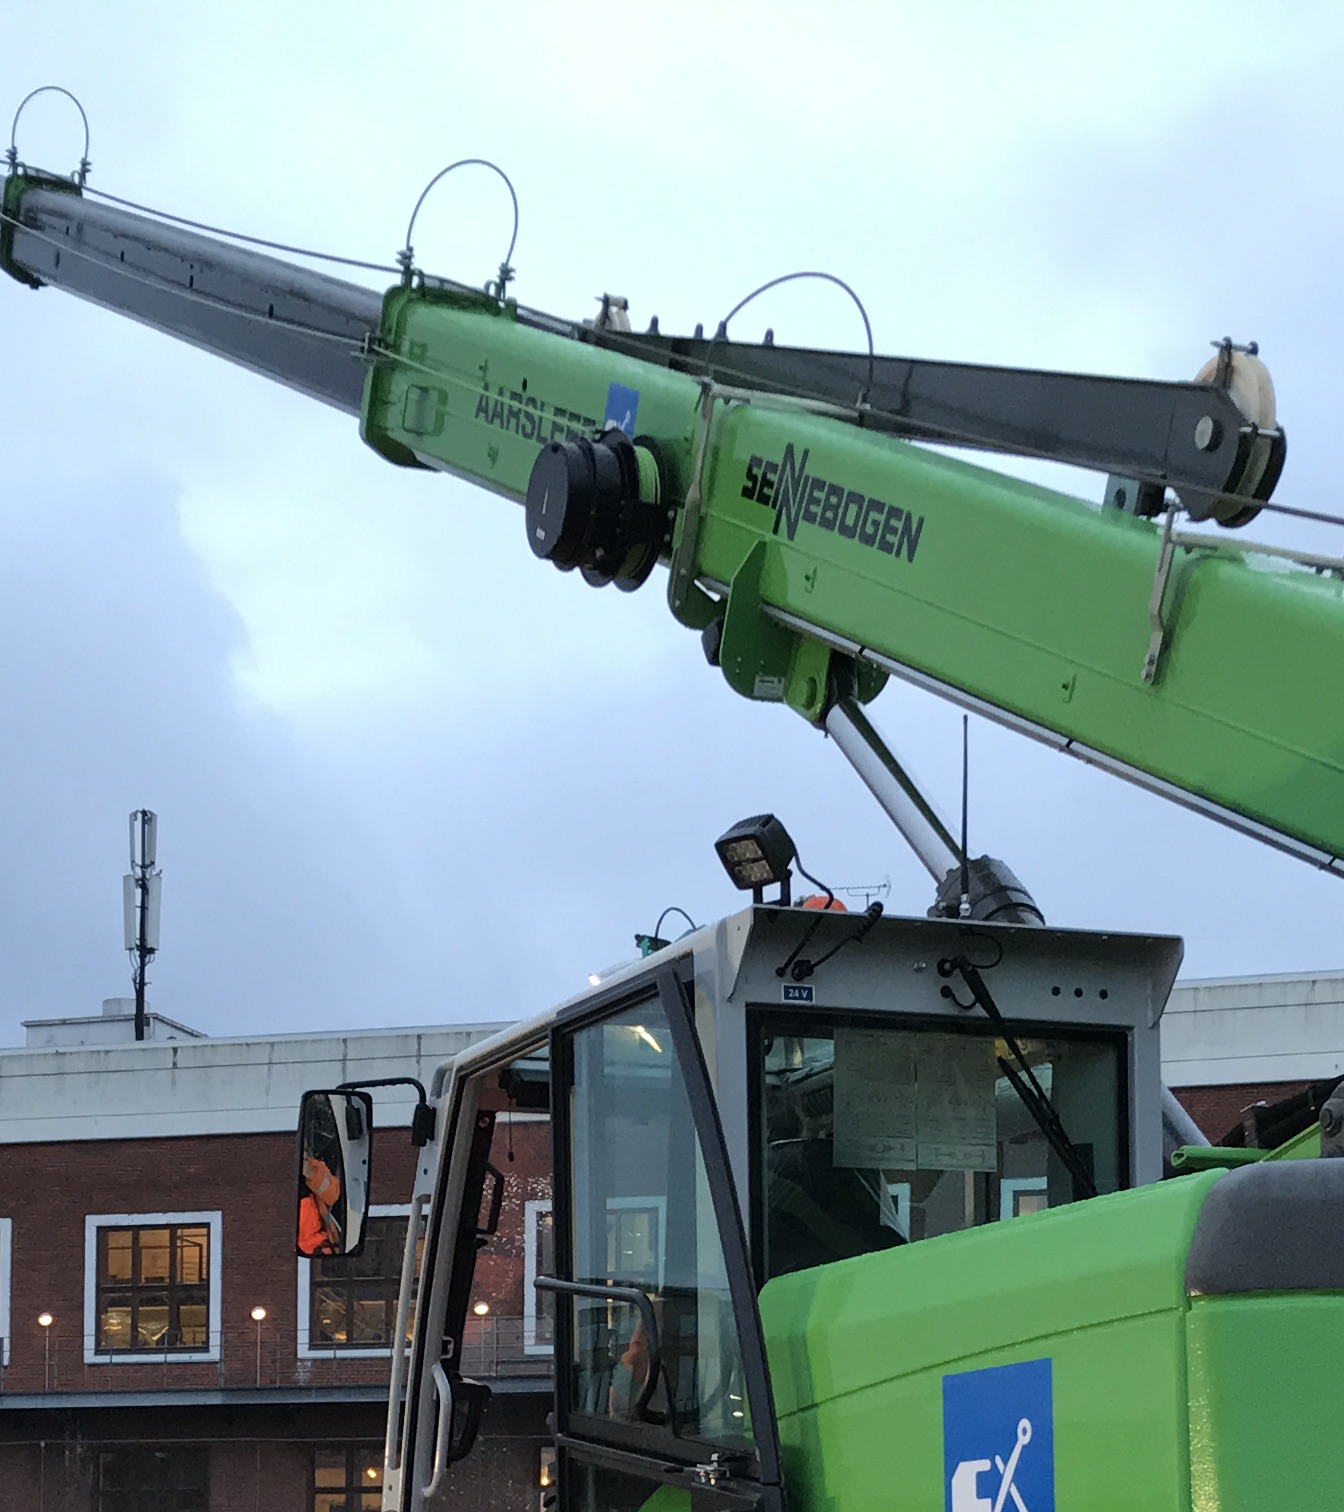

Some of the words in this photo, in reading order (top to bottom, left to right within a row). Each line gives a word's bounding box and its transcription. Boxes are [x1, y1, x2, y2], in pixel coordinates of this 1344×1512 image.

[740, 441, 925, 563] SENNEBOGEN
[788, 988, 799, 998] 24
[801, 989, 808, 998] V
